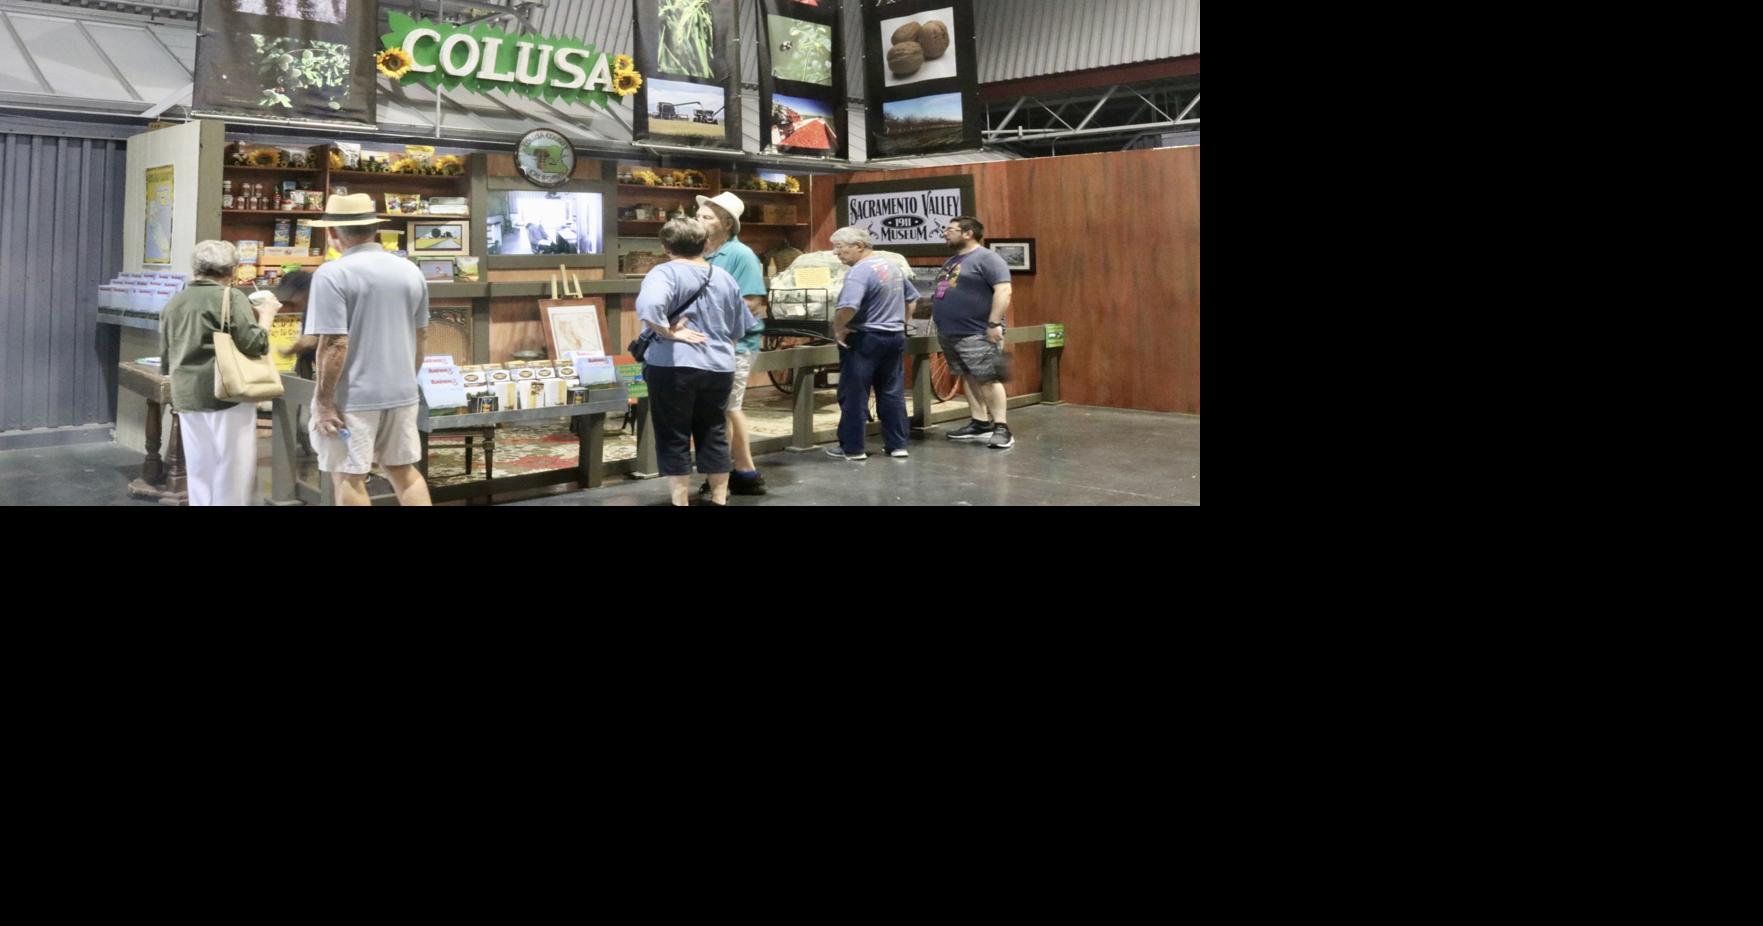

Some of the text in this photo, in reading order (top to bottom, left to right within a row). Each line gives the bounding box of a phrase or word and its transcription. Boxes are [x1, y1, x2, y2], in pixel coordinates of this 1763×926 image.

[401, 28, 617, 92] COLUSA
[850, 190, 960, 226] SACRAMENTO VALLEY
[881, 226, 928, 242] MUSEUM
[895, 218, 912, 227] 1911
